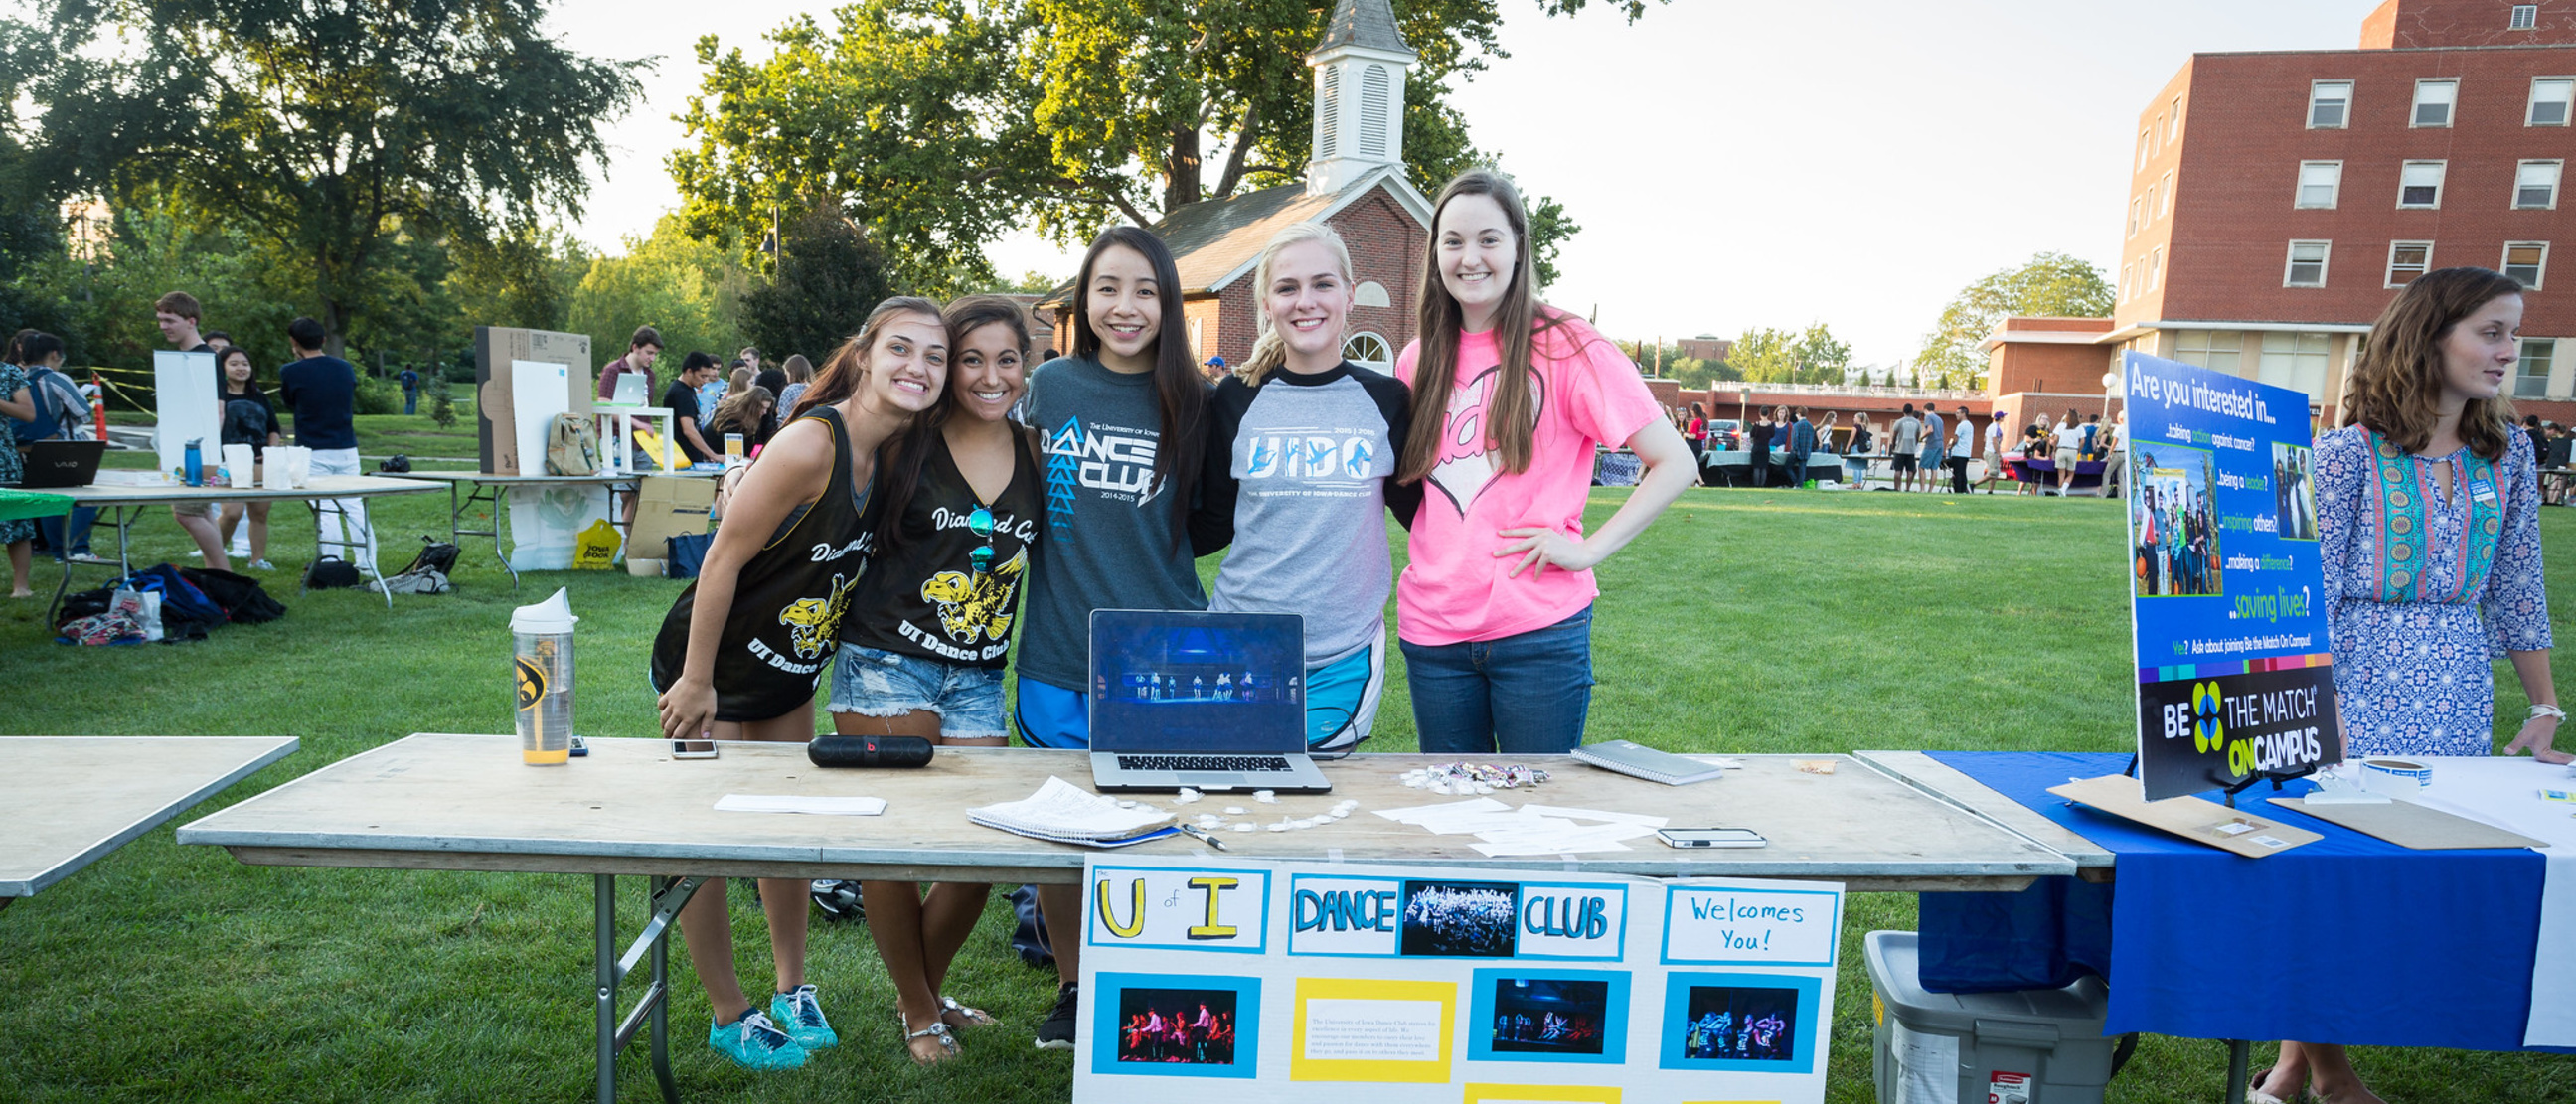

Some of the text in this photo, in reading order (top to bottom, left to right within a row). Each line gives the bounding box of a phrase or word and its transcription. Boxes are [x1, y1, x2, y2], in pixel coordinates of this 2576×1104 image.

[2131, 362, 2276, 424] Are you interested in...
[1041, 428, 1158, 466] DANCE
[2191, 428, 2211, 444] action
[2211, 432, 2234, 449] against
[2233, 437, 2255, 452] cancer?
[1248, 437, 1374, 479] UIDC
[1078, 460, 1167, 508] CLUB
[1100, 491, 1135, 503] 2014-2015
[2239, 479, 2245, 489] a
[2245, 472, 2268, 492] leader?
[2253, 513, 2278, 533] others?
[2254, 561, 2260, 570] a
[2260, 553, 2294, 571] difference?
[2278, 585, 2311, 617] lives?
[747, 637, 775, 661] UI
[767, 653, 818, 674] Dance
[898, 619, 1010, 661] UI Dance Club
[2173, 639, 2189, 655] Yes?
[2191, 639, 2204, 655] Ask
[2204, 638, 2224, 653] about
[2224, 638, 2245, 654] joining
[2244, 636, 2253, 651] Be
[2253, 635, 2263, 650] the
[2262, 634, 2280, 649] Match
[2280, 634, 2289, 648] On
[2164, 702, 2190, 739] BE
[2224, 694, 2260, 730] THE
[1097, 877, 1239, 940] U of I
[1295, 889, 1608, 939] DANCE CLUB
[1691, 897, 1804, 922] Welcomes
[1721, 929, 1771, 951] You!
